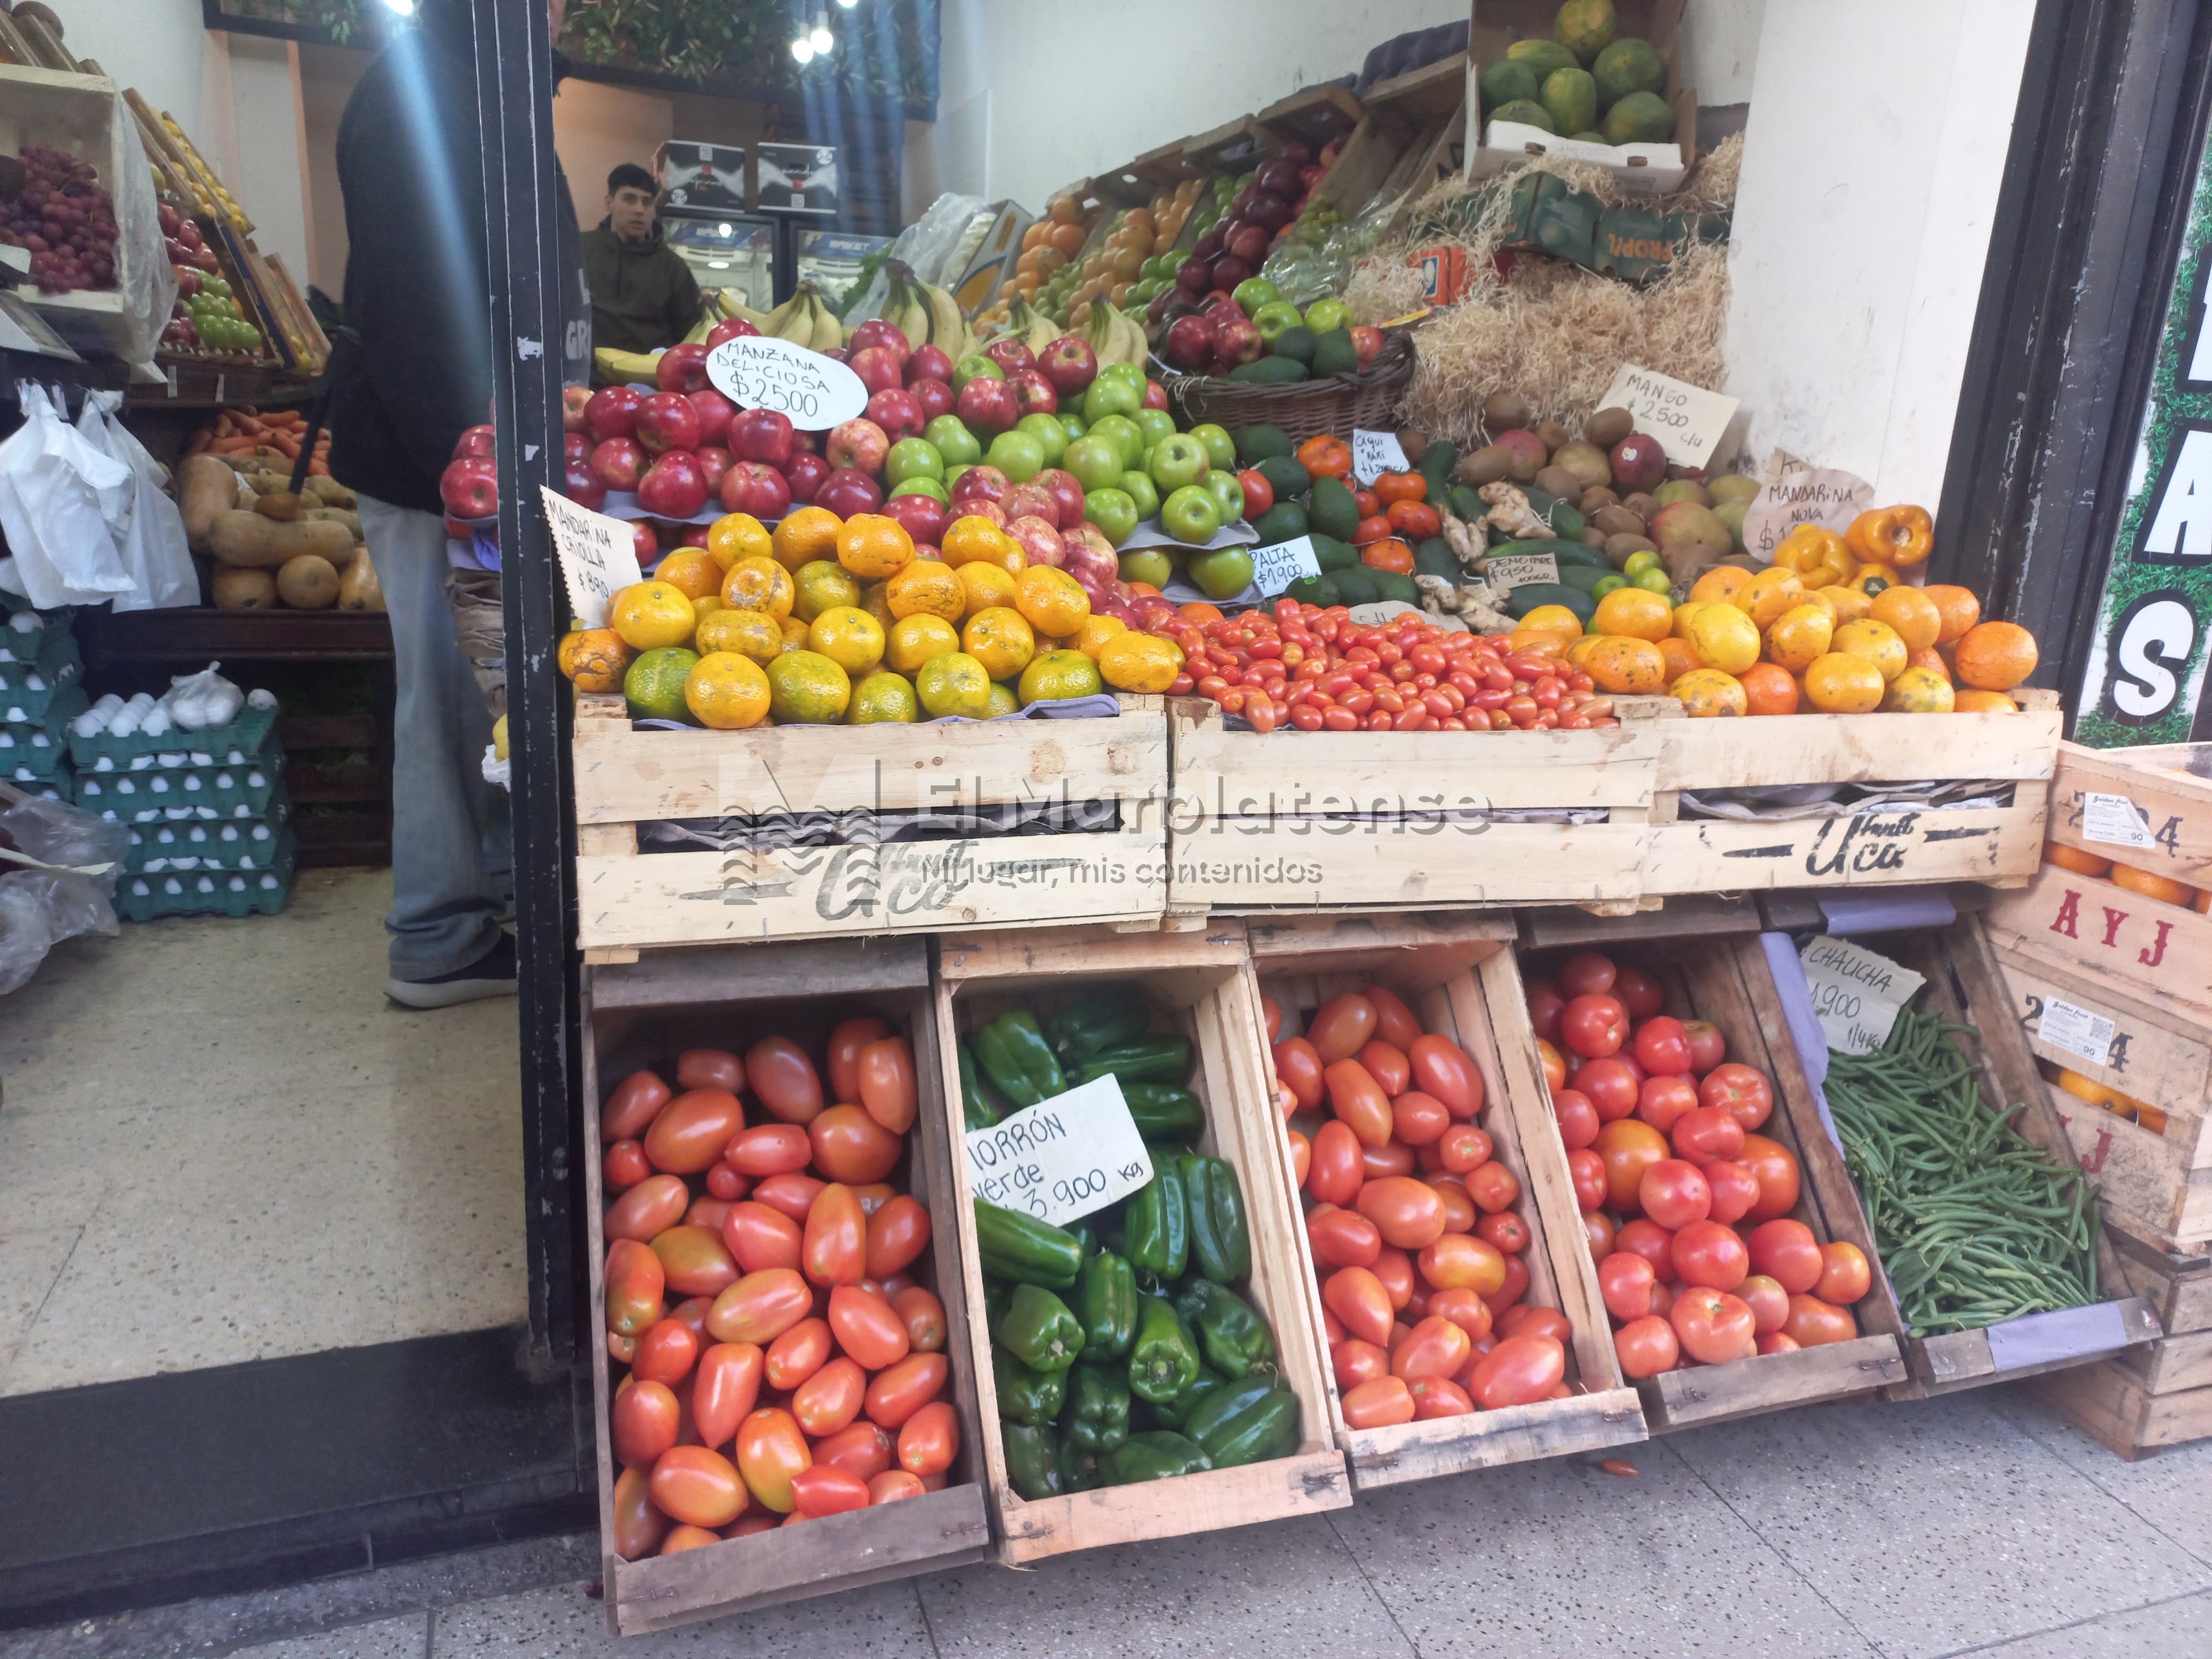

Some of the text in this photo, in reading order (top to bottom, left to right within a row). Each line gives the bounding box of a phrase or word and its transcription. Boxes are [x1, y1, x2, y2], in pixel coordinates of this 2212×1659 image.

[727, 343, 820, 374] MANZANA
[1626, 374, 1687, 407] MANGO
[1791, 506, 1824, 522] NOVA
[1249, 547, 1296, 568] PALTA
[2131, 832, 2143, 841] 90
[1809, 946, 1892, 993] CHAUCHA
[2083, 1045, 2096, 1056] 90
[967, 1109, 1067, 1171] ORRÓN
[971, 1163, 1044, 1201] verde
